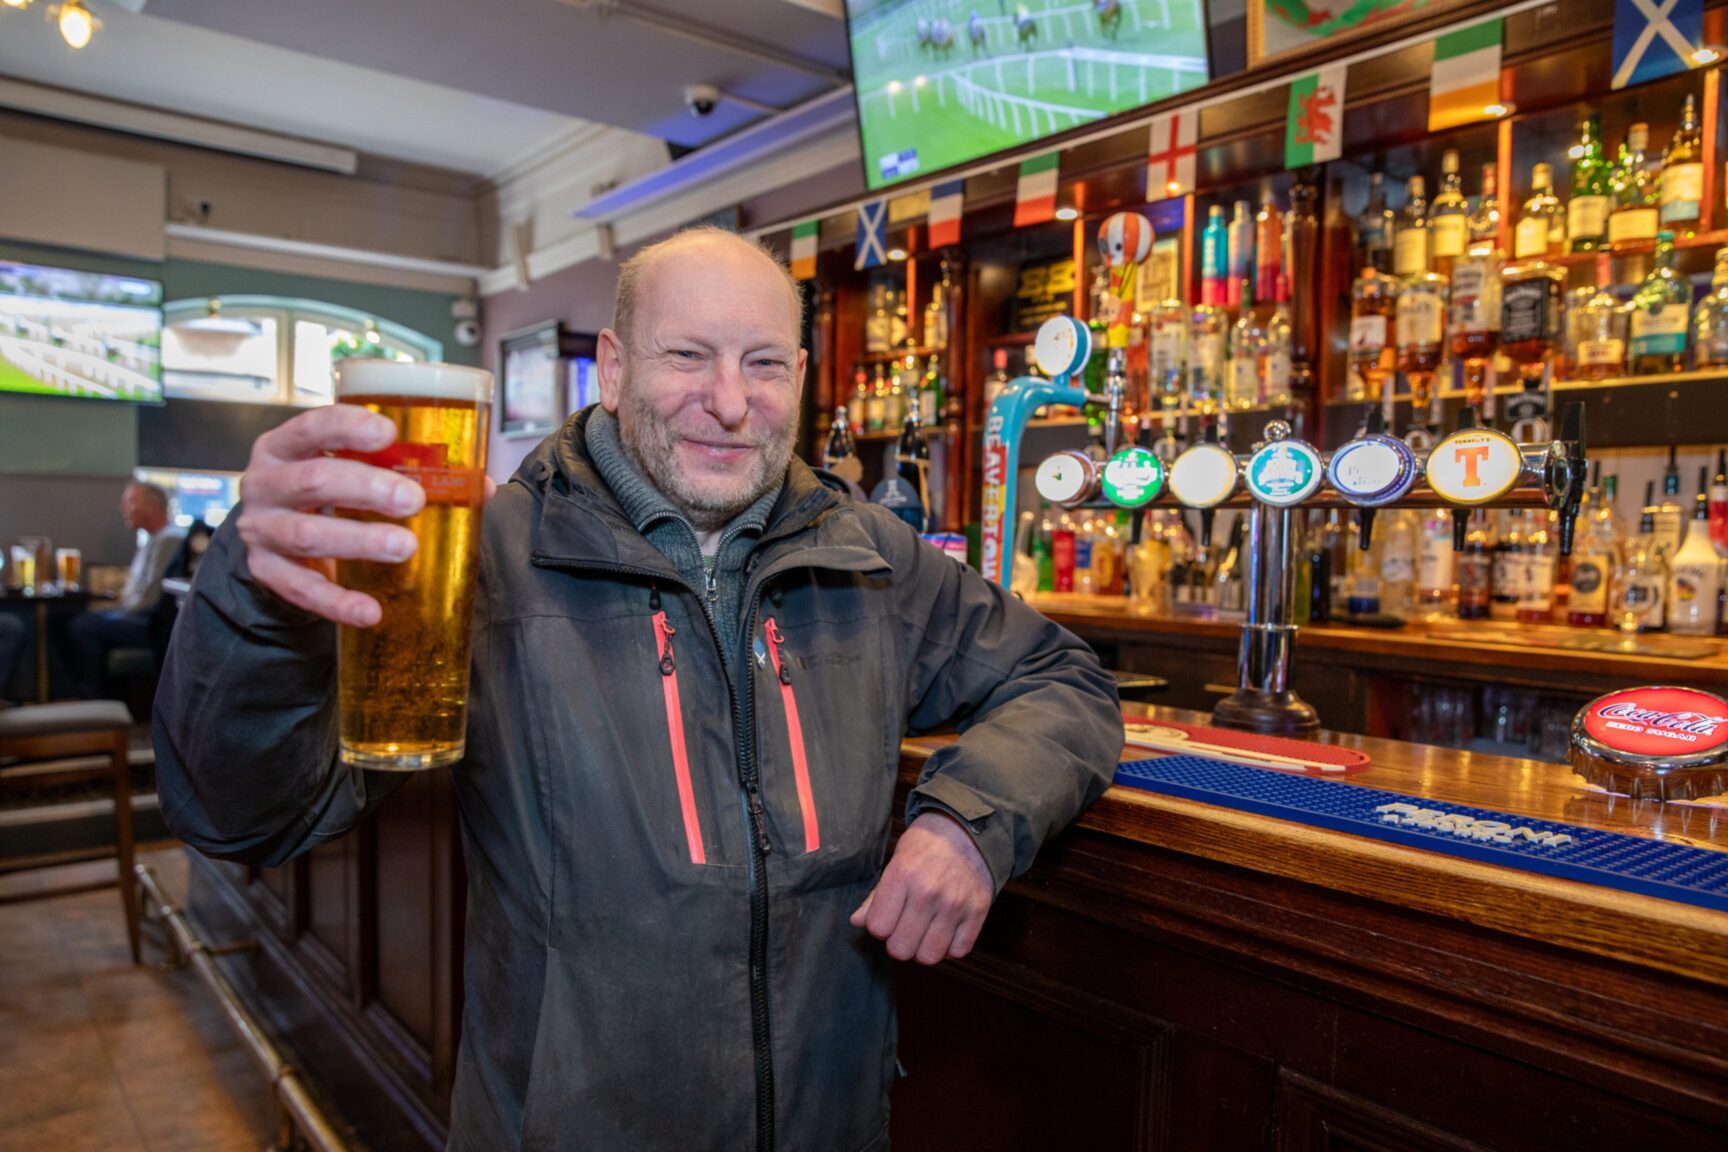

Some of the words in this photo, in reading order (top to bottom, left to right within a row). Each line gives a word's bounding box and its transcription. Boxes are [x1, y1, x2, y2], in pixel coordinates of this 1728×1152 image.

[1455, 445, 1489, 487] T
[983, 415, 1004, 583] BEAVERTOW
[1605, 721, 1644, 732] ZERO
[1646, 728, 1697, 741] SUGAR
